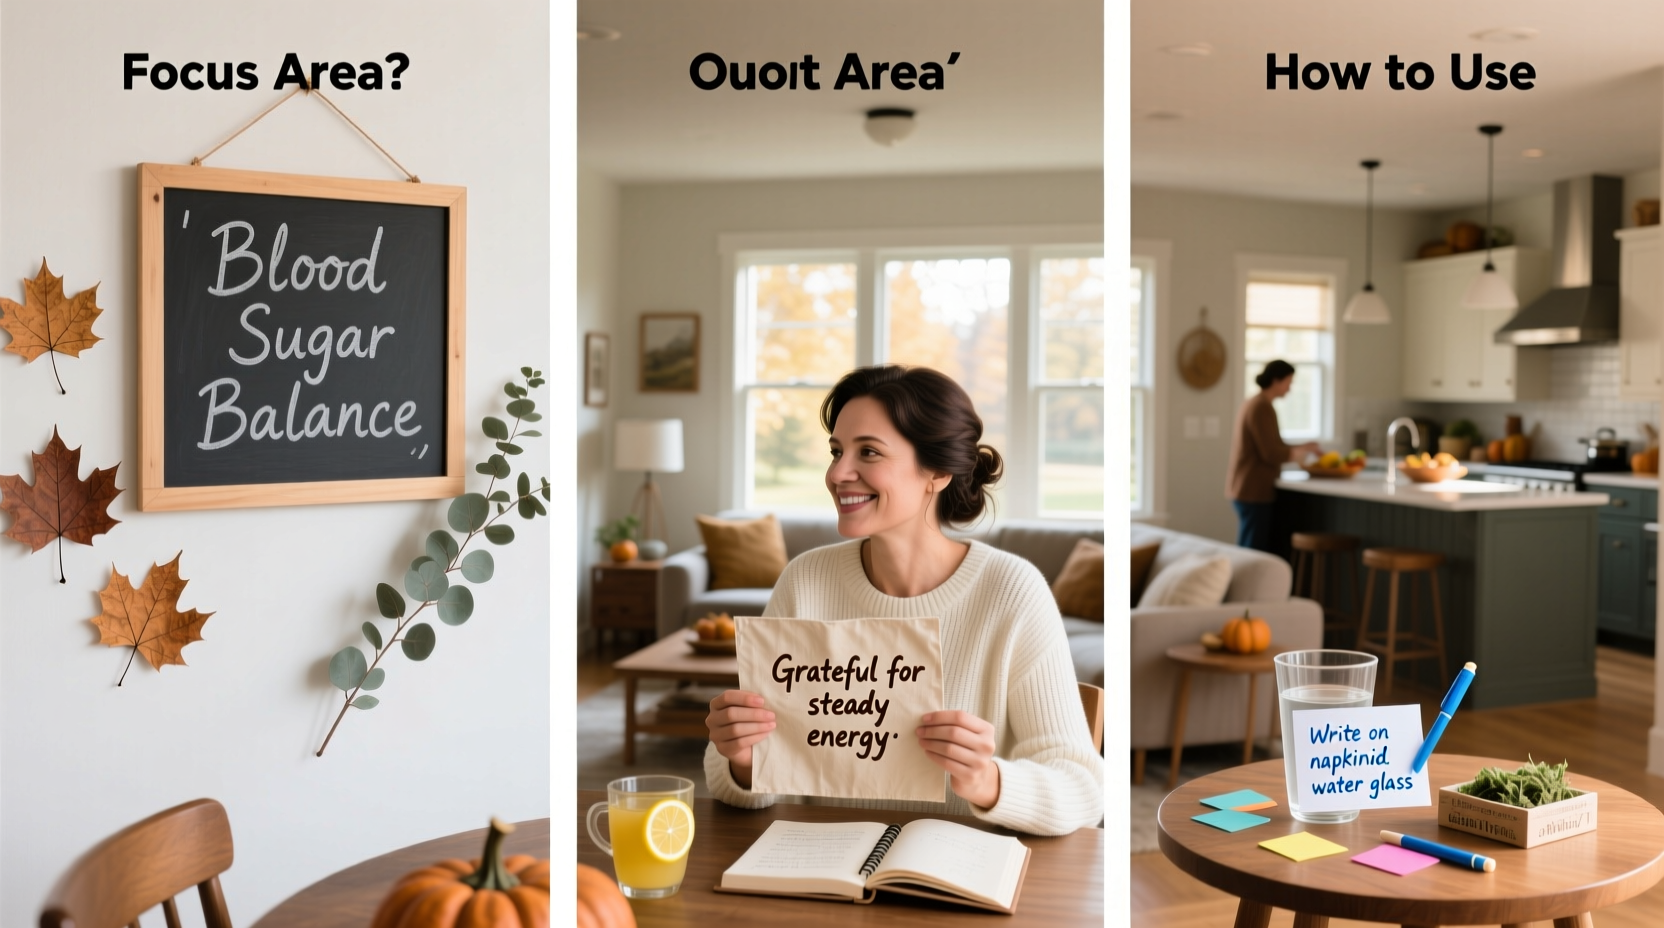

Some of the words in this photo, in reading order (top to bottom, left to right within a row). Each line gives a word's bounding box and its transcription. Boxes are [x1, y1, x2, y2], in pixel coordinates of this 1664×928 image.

[228, 302, 396, 386] Sugar
[771, 653, 879, 693] Grateful
[886, 654, 926, 689] for
[807, 689, 890, 728] steady
[1310, 723, 1361, 745] Write
[1368, 727, 1389, 741] on
[1312, 776, 1364, 795] water
[1369, 771, 1414, 800] glass
